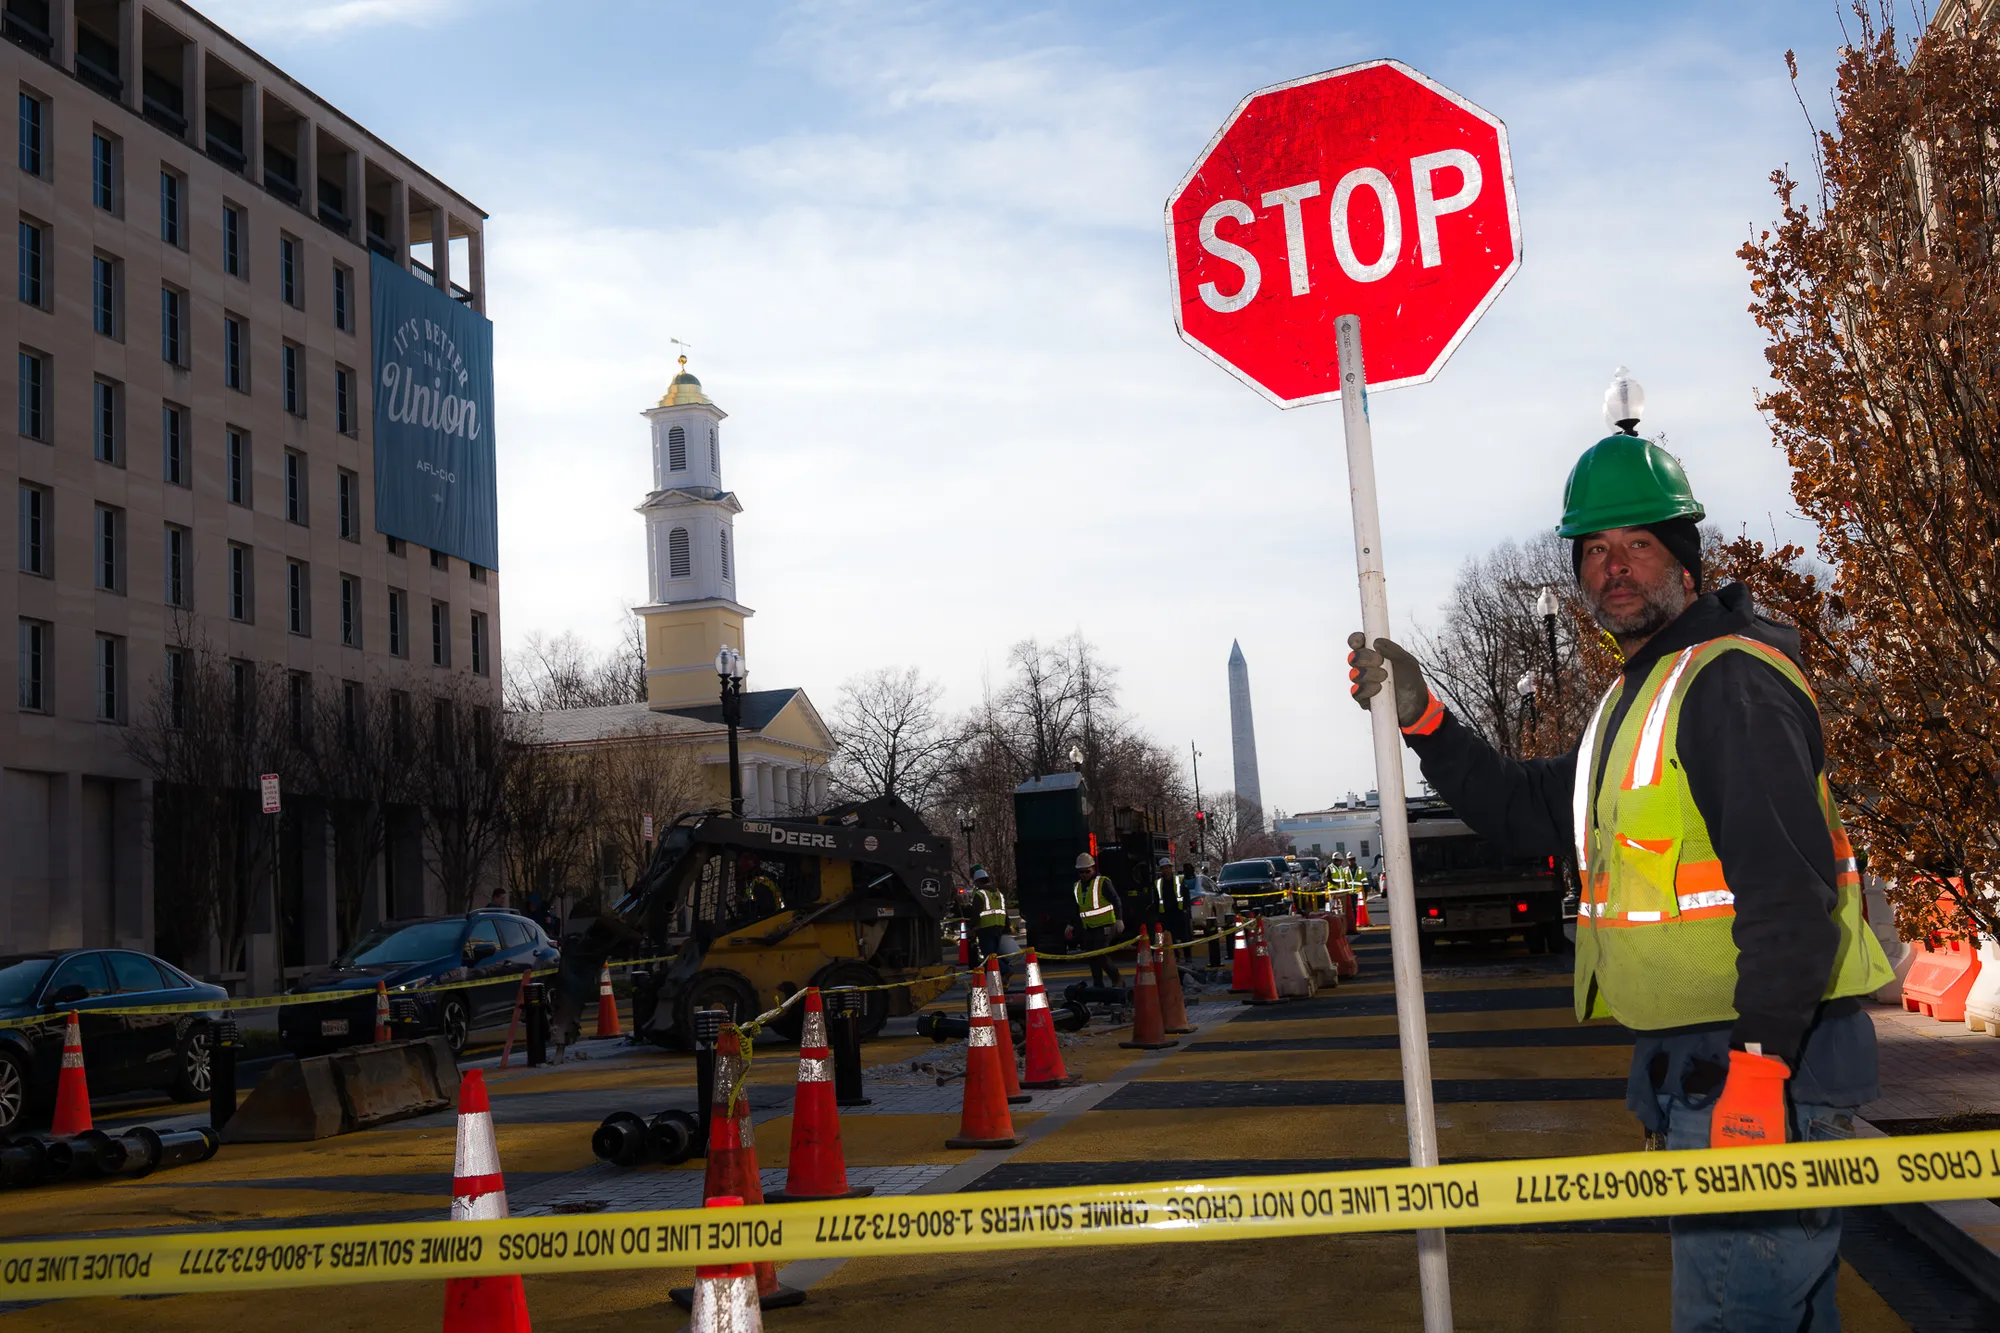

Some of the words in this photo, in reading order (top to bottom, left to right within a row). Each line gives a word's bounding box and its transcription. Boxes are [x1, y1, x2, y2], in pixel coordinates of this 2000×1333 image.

[1198, 148, 1482, 313] STOP
[393, 317, 419, 356] IT'S
[425, 318, 469, 388] BETTER
[423, 350, 433, 368] IN
[436, 359, 442, 373] A
[382, 361, 481, 441] Union
[416, 459, 456, 484] AFL-CIO
[770, 826, 837, 848] DEERE
[1695, 1161, 1797, 1194] SOLVERS
[1802, 1156, 1880, 1188] CRIME
[1898, 1149, 1982, 1183] CROSS
[1339, 1184, 1390, 1215] LINE
[1395, 1180, 1480, 1212] POLICE
[1516, 1167, 1689, 1204] 1-800-673-2777
[1080, 1199, 1149, 1229] CRIME
[1166, 1193, 1243, 1224] CROSS
[1251, 1191, 1295, 1218] NOT
[1301, 1188, 1333, 1217] DO
[815, 1208, 973, 1242] 1-800-673-2777
[981, 1203, 1073, 1234] SOLVERS
[499, 1231, 568, 1261] CROSS
[573, 1228, 616, 1257] NOT
[621, 1226, 650, 1254] DO
[656, 1223, 702, 1252] LINE
[708, 1219, 783, 1249] POLICE
[179, 1243, 325, 1275] 1-800-673-2777
[330, 1238, 415, 1269] SOLVERS
[419, 1235, 482, 1264] CRIME
[4, 1257, 30, 1284] DO
[36, 1254, 79, 1282] LINE
[83, 1252, 152, 1280] POLICE
